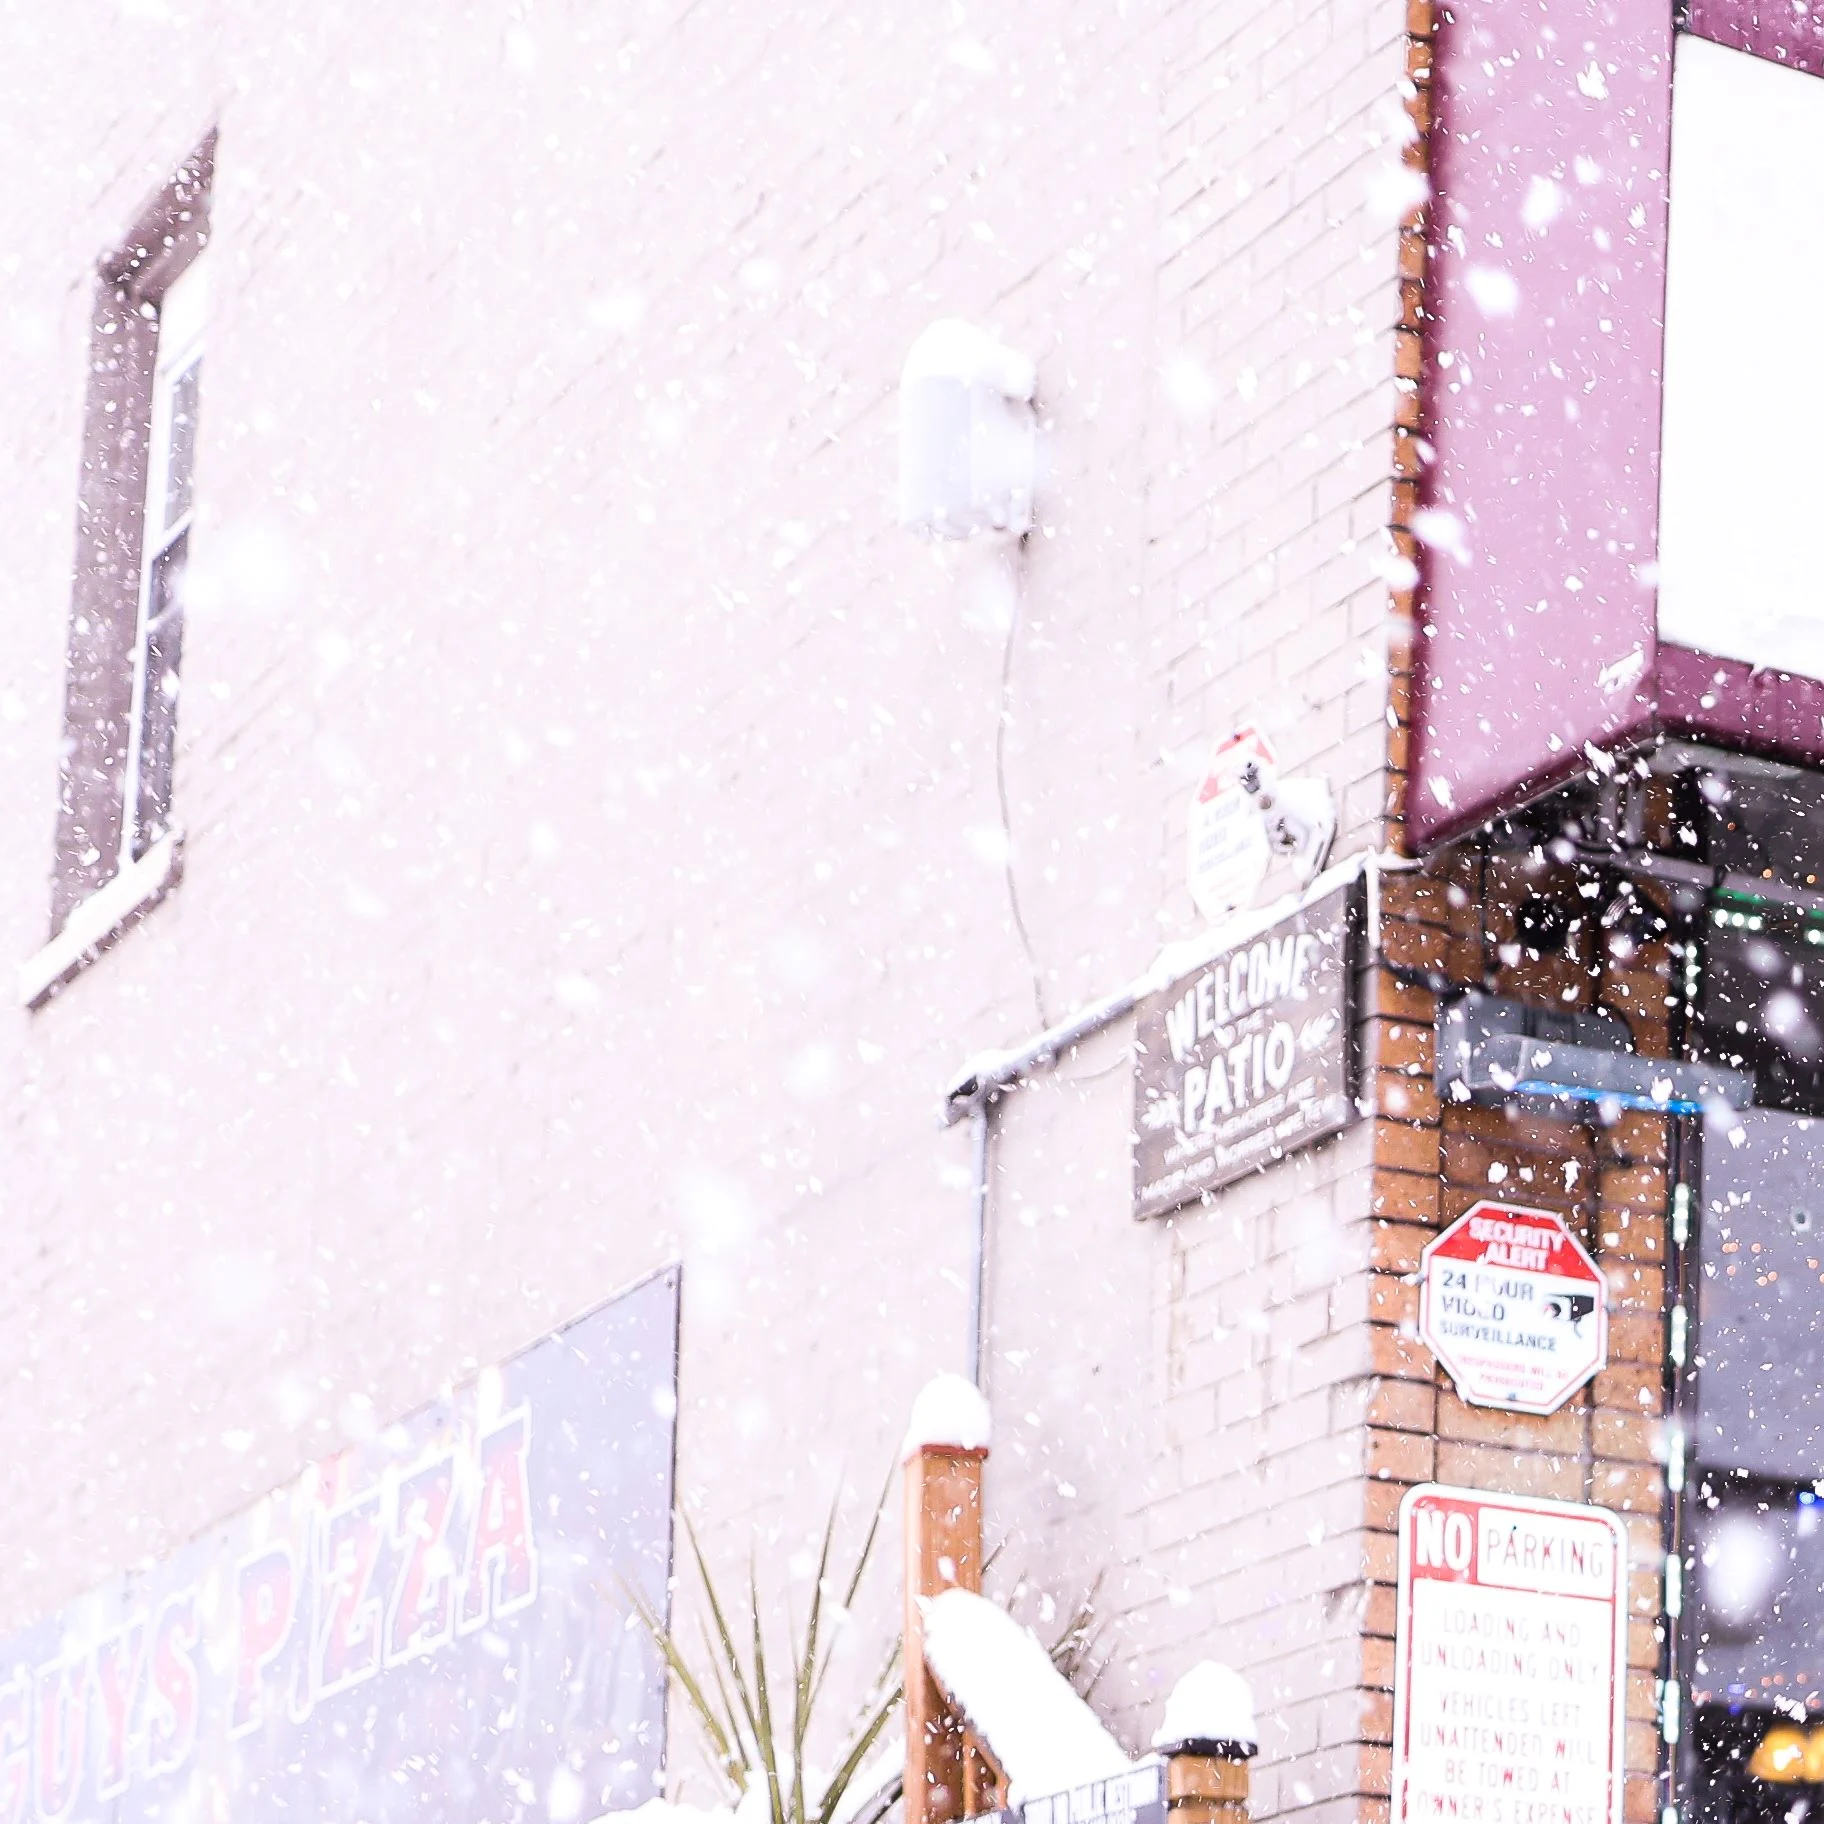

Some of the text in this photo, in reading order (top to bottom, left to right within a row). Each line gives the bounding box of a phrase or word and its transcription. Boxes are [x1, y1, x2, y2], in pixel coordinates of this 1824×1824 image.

[1165, 934, 1318, 1063] WELCOME
[1184, 1021, 1295, 1133] PATIO
[1468, 1216, 1567, 1252] SECURITY
[1484, 1241, 1549, 1271] ALERT
[1442, 1269, 1467, 1290] 24
[1440, 1320, 1557, 1352] SURVEILLANCE
[1415, 1509, 1604, 1579] NO PARKING
[1444, 1607, 1580, 1648] LOADING AND
[1421, 1642, 1598, 1685] UNLOADING ONLY
[1440, 1690, 1581, 1728] VEHICLES LEFT
[1445, 1758, 1571, 1794] BE TOWED AT
